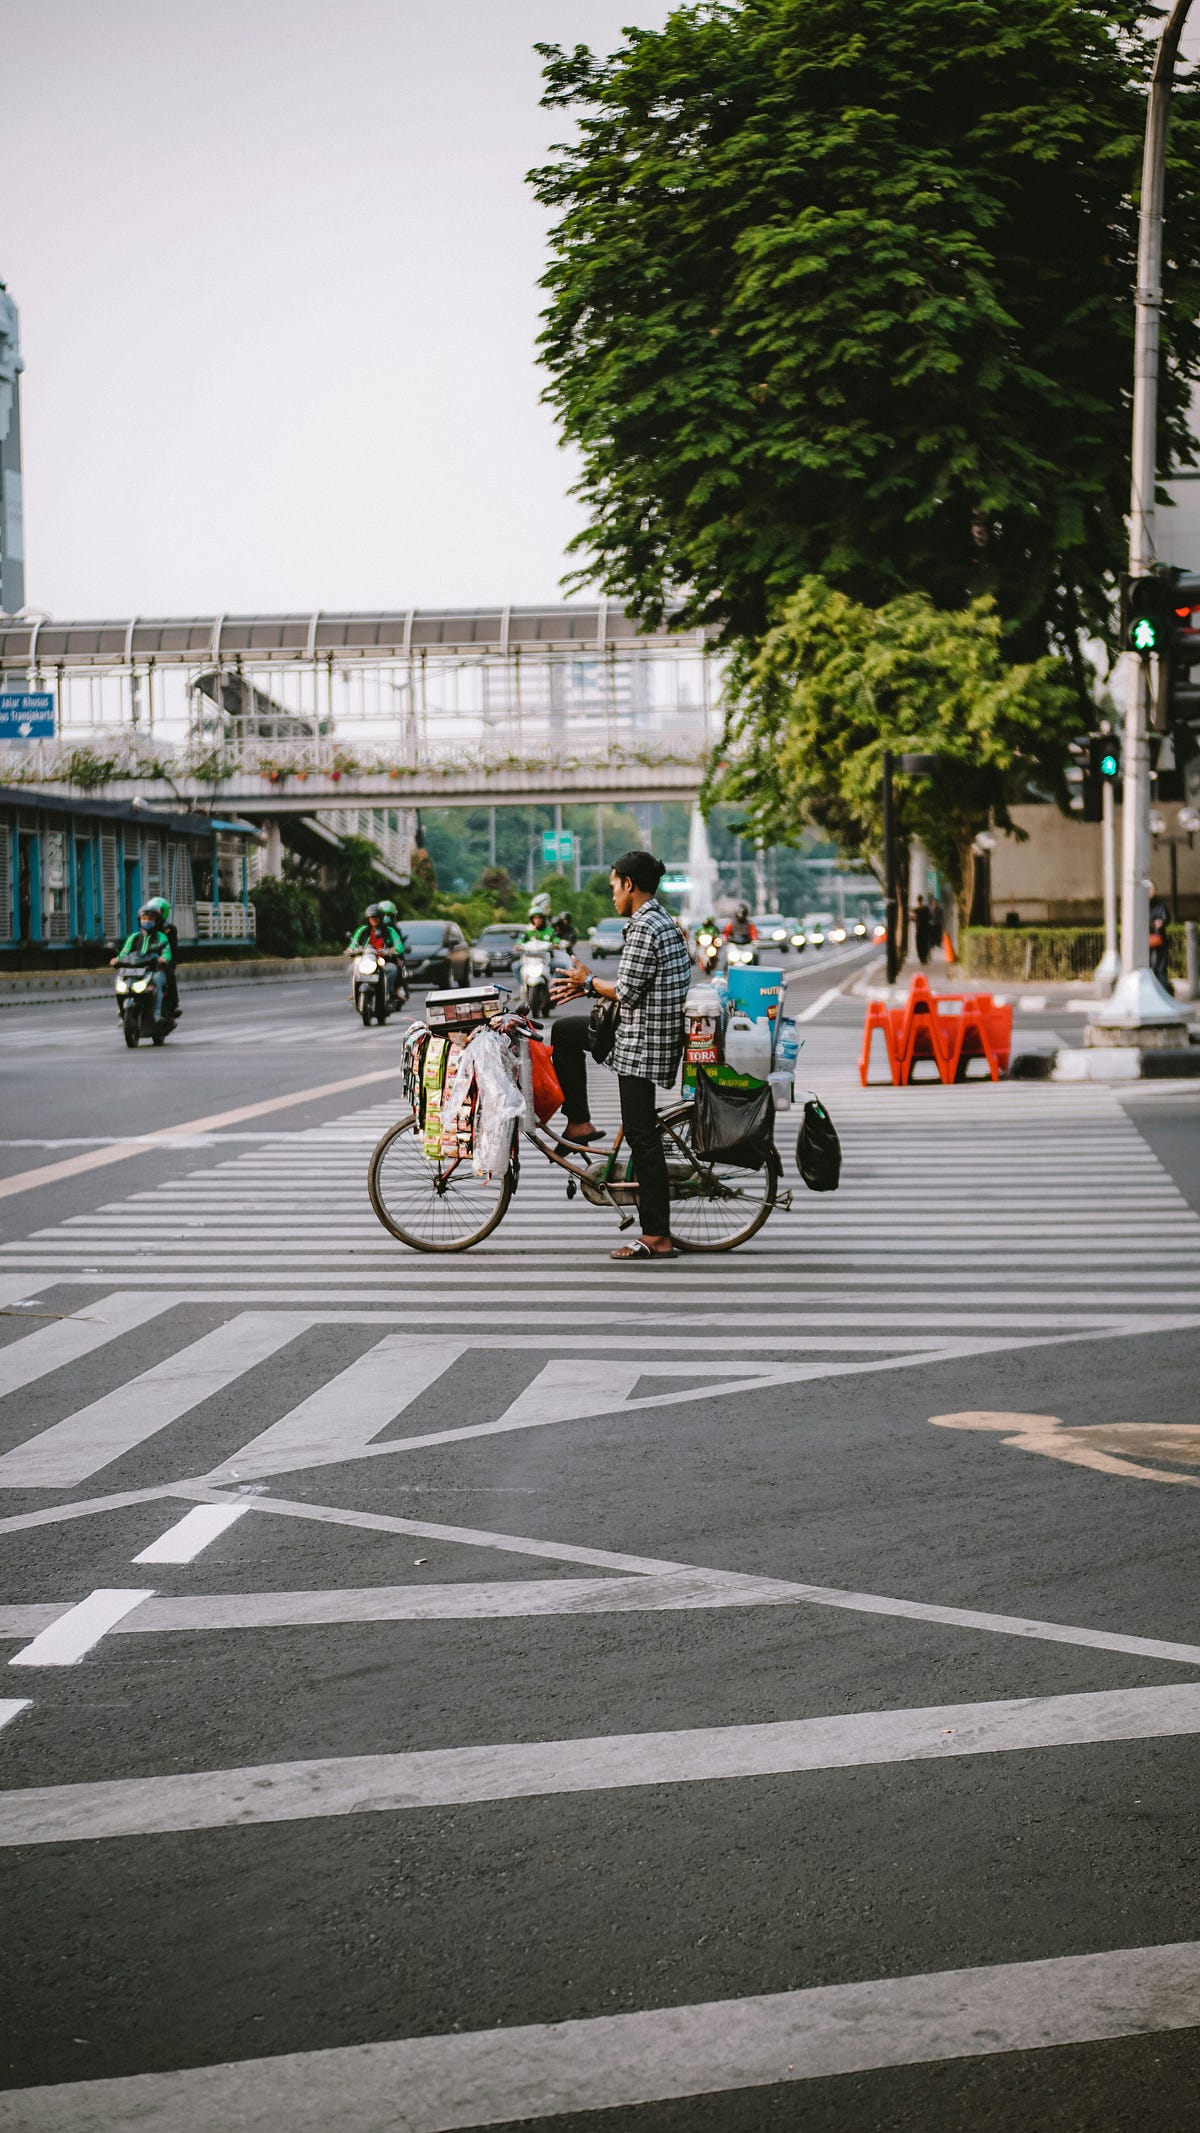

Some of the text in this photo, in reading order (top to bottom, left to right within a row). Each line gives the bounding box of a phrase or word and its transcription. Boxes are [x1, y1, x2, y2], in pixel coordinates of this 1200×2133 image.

[1, 697, 49, 708] Jalur Khusus
[689, 1051, 716, 1060] TORA
